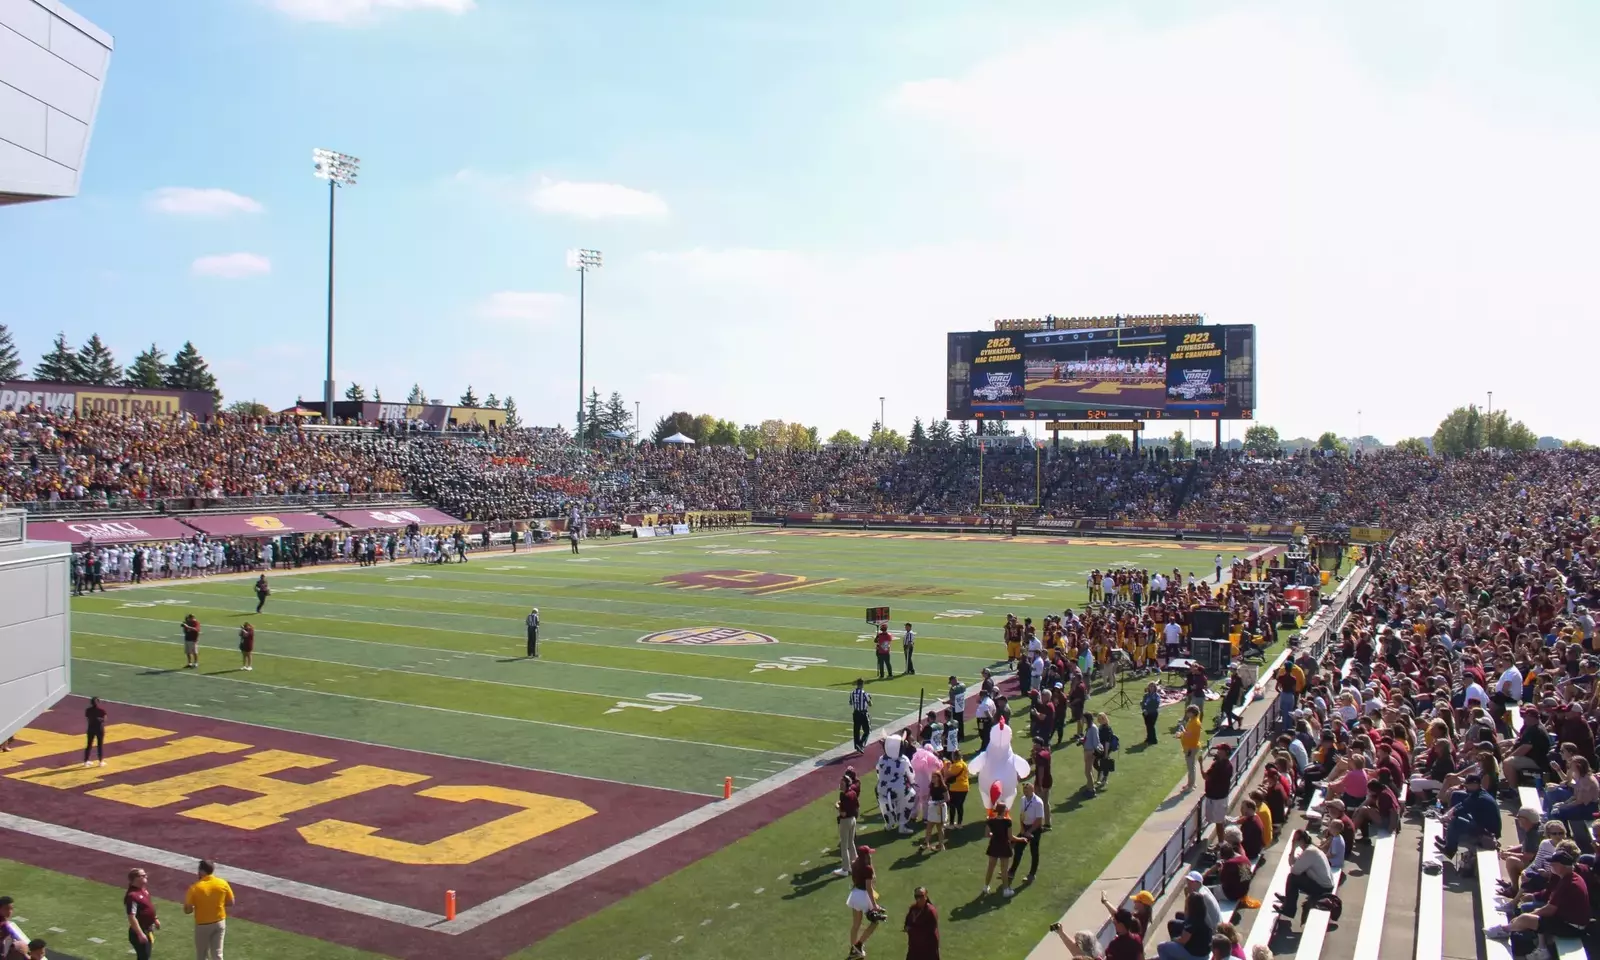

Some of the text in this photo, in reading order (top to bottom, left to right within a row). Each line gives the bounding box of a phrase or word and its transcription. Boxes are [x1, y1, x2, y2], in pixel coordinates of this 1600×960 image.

[986, 337, 1011, 349] 2023
[1183, 332, 1211, 345] 2023
[980, 347, 1016, 356] GYMNASTICS
[1176, 342, 1216, 352] GYMNASTICS
[988, 353, 1021, 362] CHAMPIONS
[1184, 349, 1222, 359] CHAMPIONS
[82, 397, 172, 417] FOOTBALL
[378, 404, 407, 420] FIRE
[1087, 410, 1107, 419] 5:24
[68, 522, 139, 534] CMU
[751, 656, 828, 673] 20
[608, 692, 703, 713] 10
